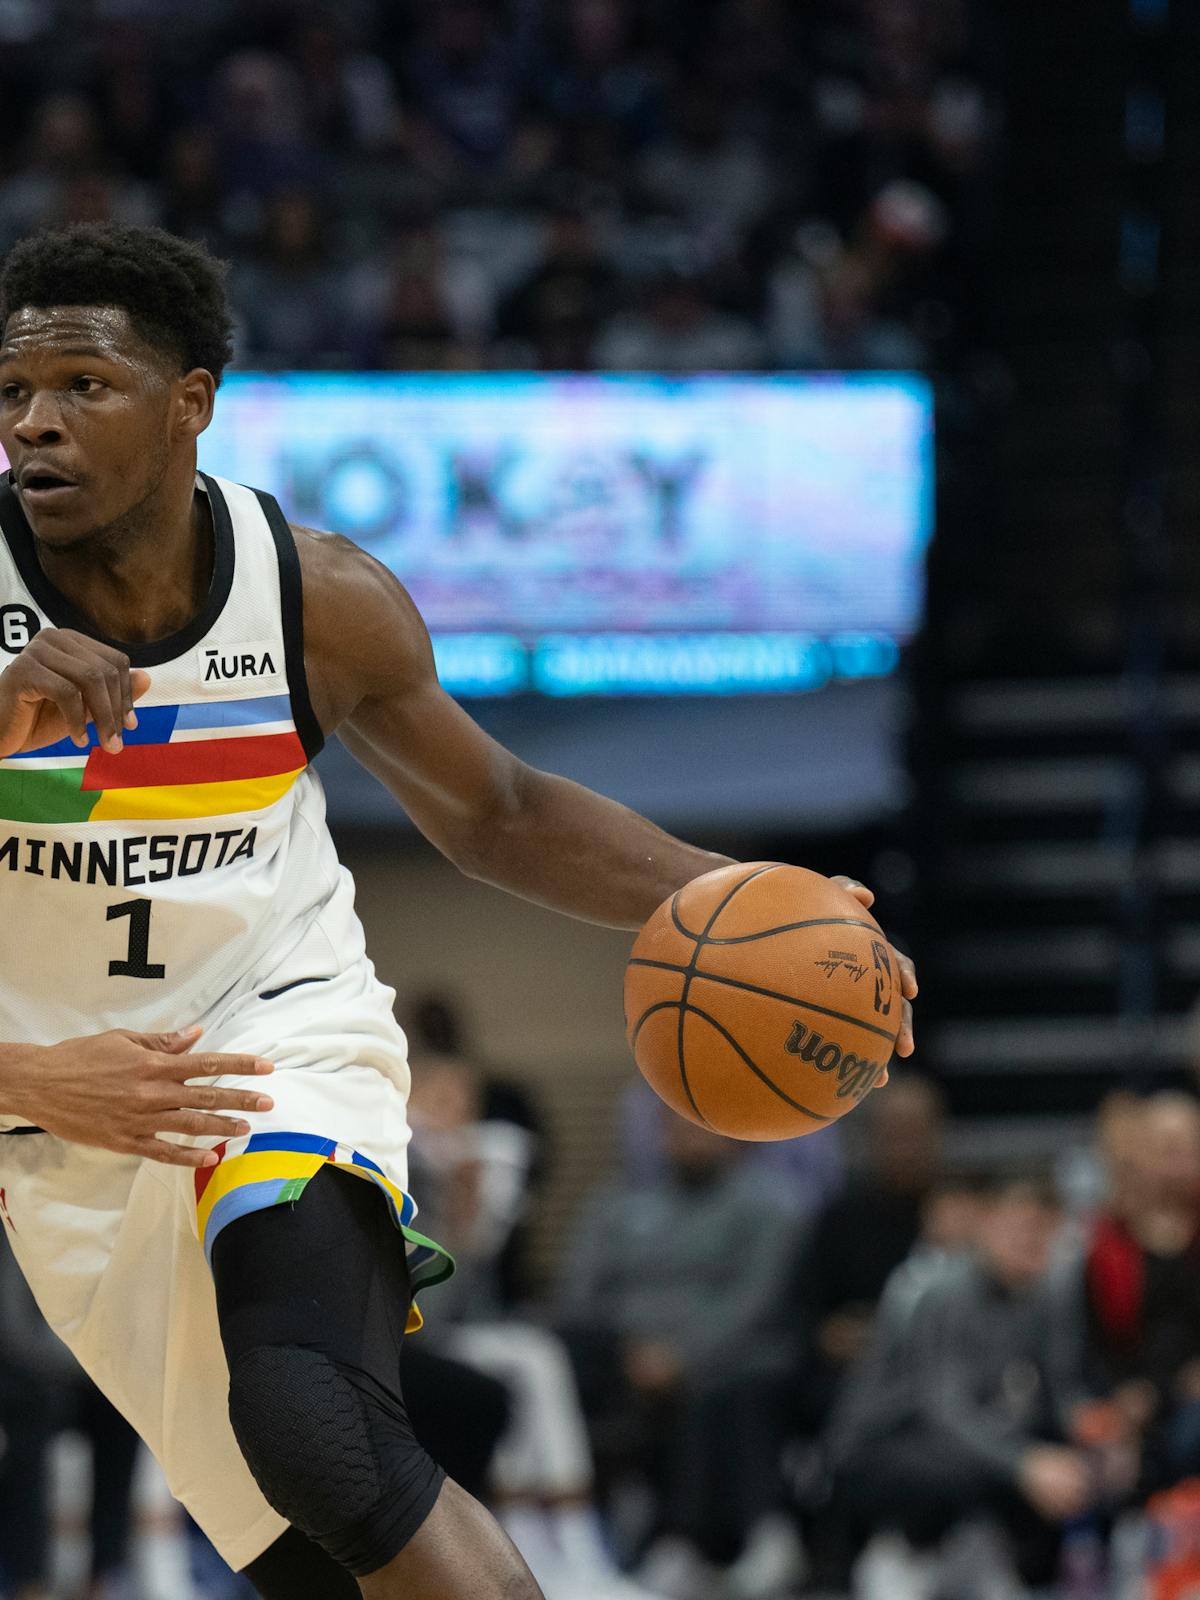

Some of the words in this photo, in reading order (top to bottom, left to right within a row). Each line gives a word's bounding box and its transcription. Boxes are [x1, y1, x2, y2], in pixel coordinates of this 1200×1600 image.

[2, 610, 30, 648] 6
[106, 898, 166, 979] 1
[784, 1019, 884, 1101] ilson
